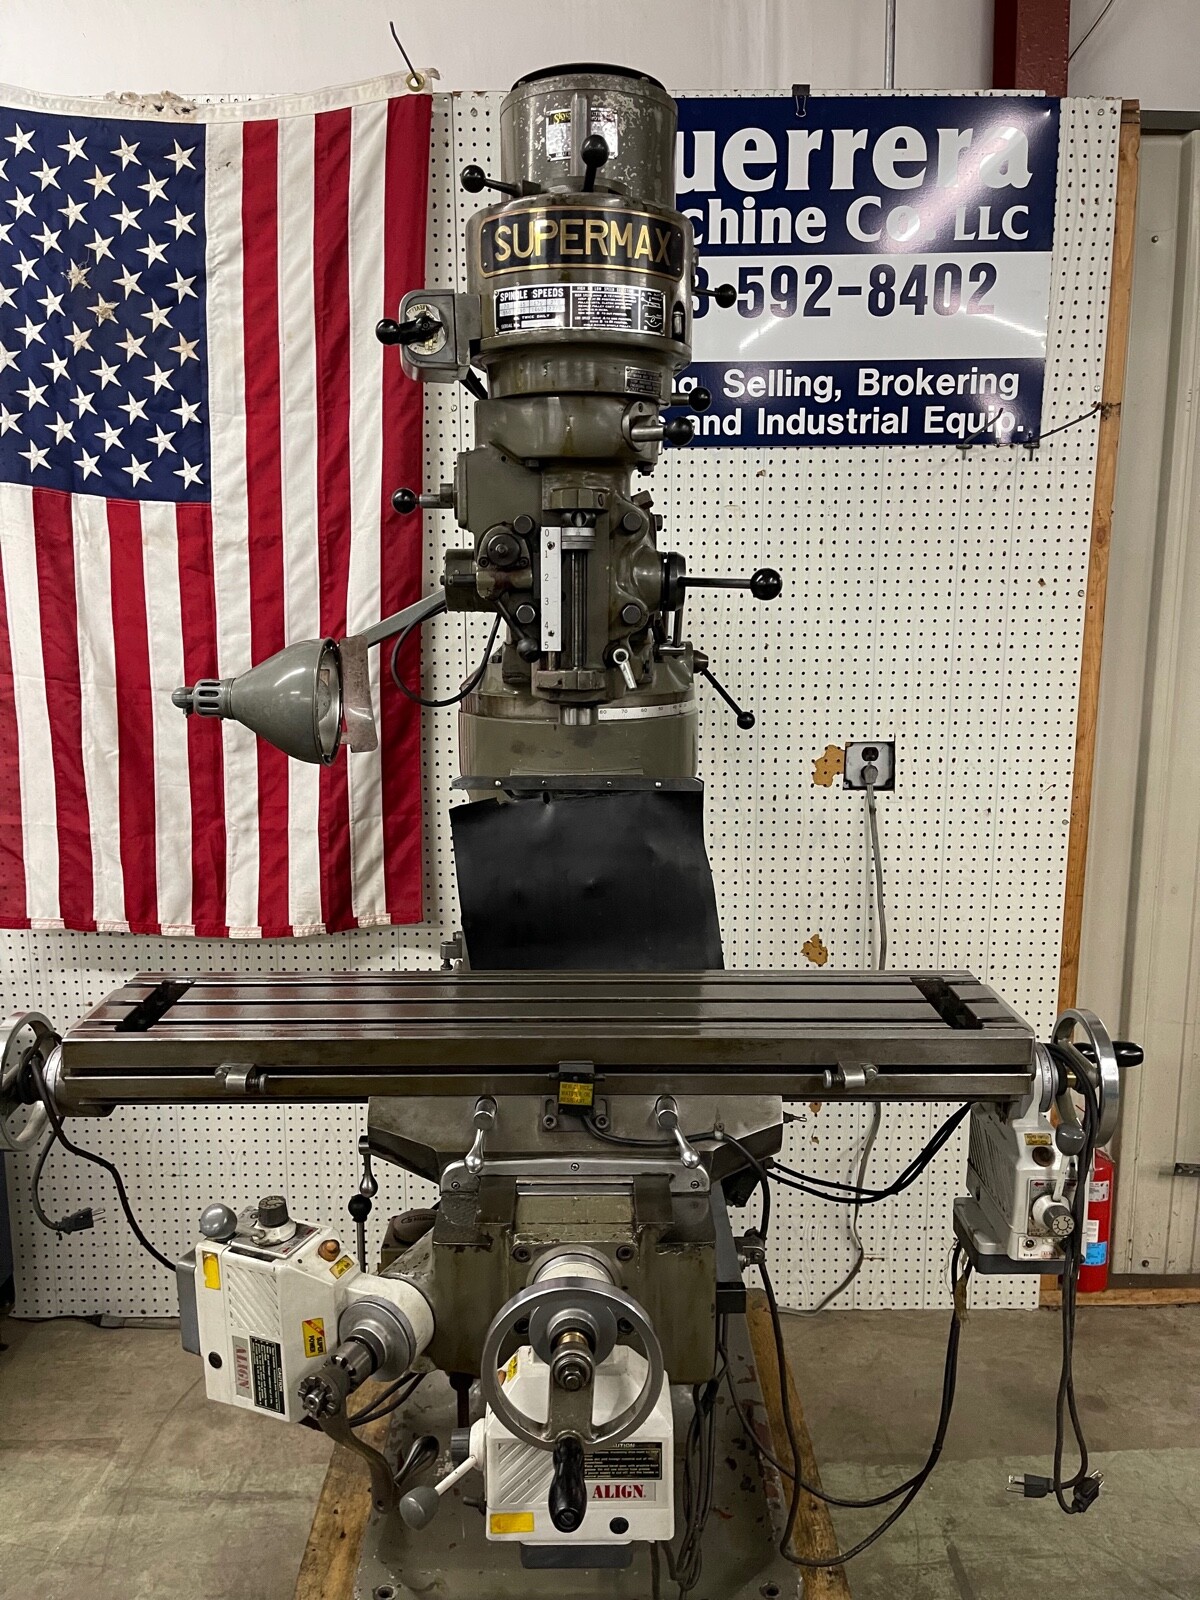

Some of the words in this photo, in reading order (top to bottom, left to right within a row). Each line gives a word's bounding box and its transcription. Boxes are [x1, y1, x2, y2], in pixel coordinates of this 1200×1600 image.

[676, 125, 1033, 194] uerrera
[681, 196, 827, 246] chine
[846, 195, 936, 243] Co.
[953, 205, 1029, 241] LLC
[494, 218, 672, 266] SUPERMAX
[500, 289, 528, 302] SPINLE
[532, 287, 564, 298] SPEEDS
[722, 368, 842, 404] Selling,
[858, 366, 1020, 401] Brokering
[757, 406, 909, 436] Industrial
[924, 405, 1024, 439] Equip.
[544, 529, 550, 537] 0
[544, 550, 549, 558] 1
[544, 573, 550, 581] 2
[544, 597, 550, 605] 3
[544, 621, 549, 629] 4
[544, 641, 549, 649] 5
[236, 1345, 250, 1389] ALIGN
[592, 1484, 644, 1499] ALIGN
